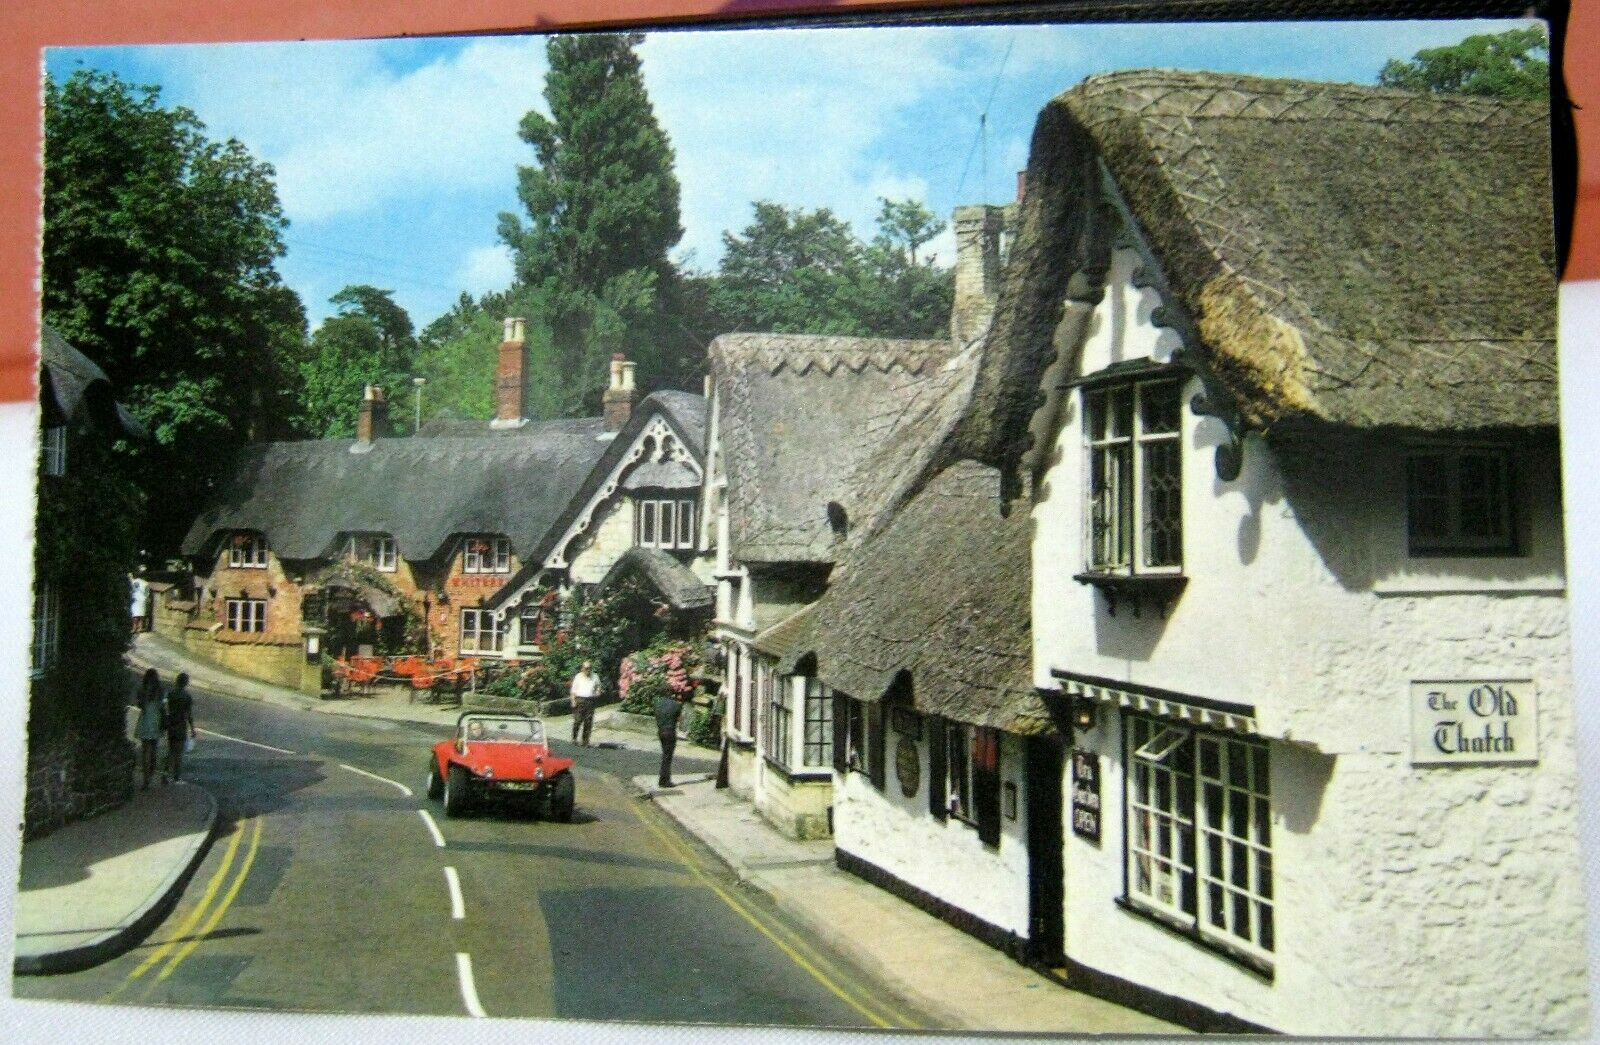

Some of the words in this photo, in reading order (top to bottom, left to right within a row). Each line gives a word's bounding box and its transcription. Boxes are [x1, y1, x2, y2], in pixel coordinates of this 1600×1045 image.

[1427, 691, 1458, 711] The
[1468, 684, 1518, 717] Old
[1433, 720, 1515, 754] Thatch
